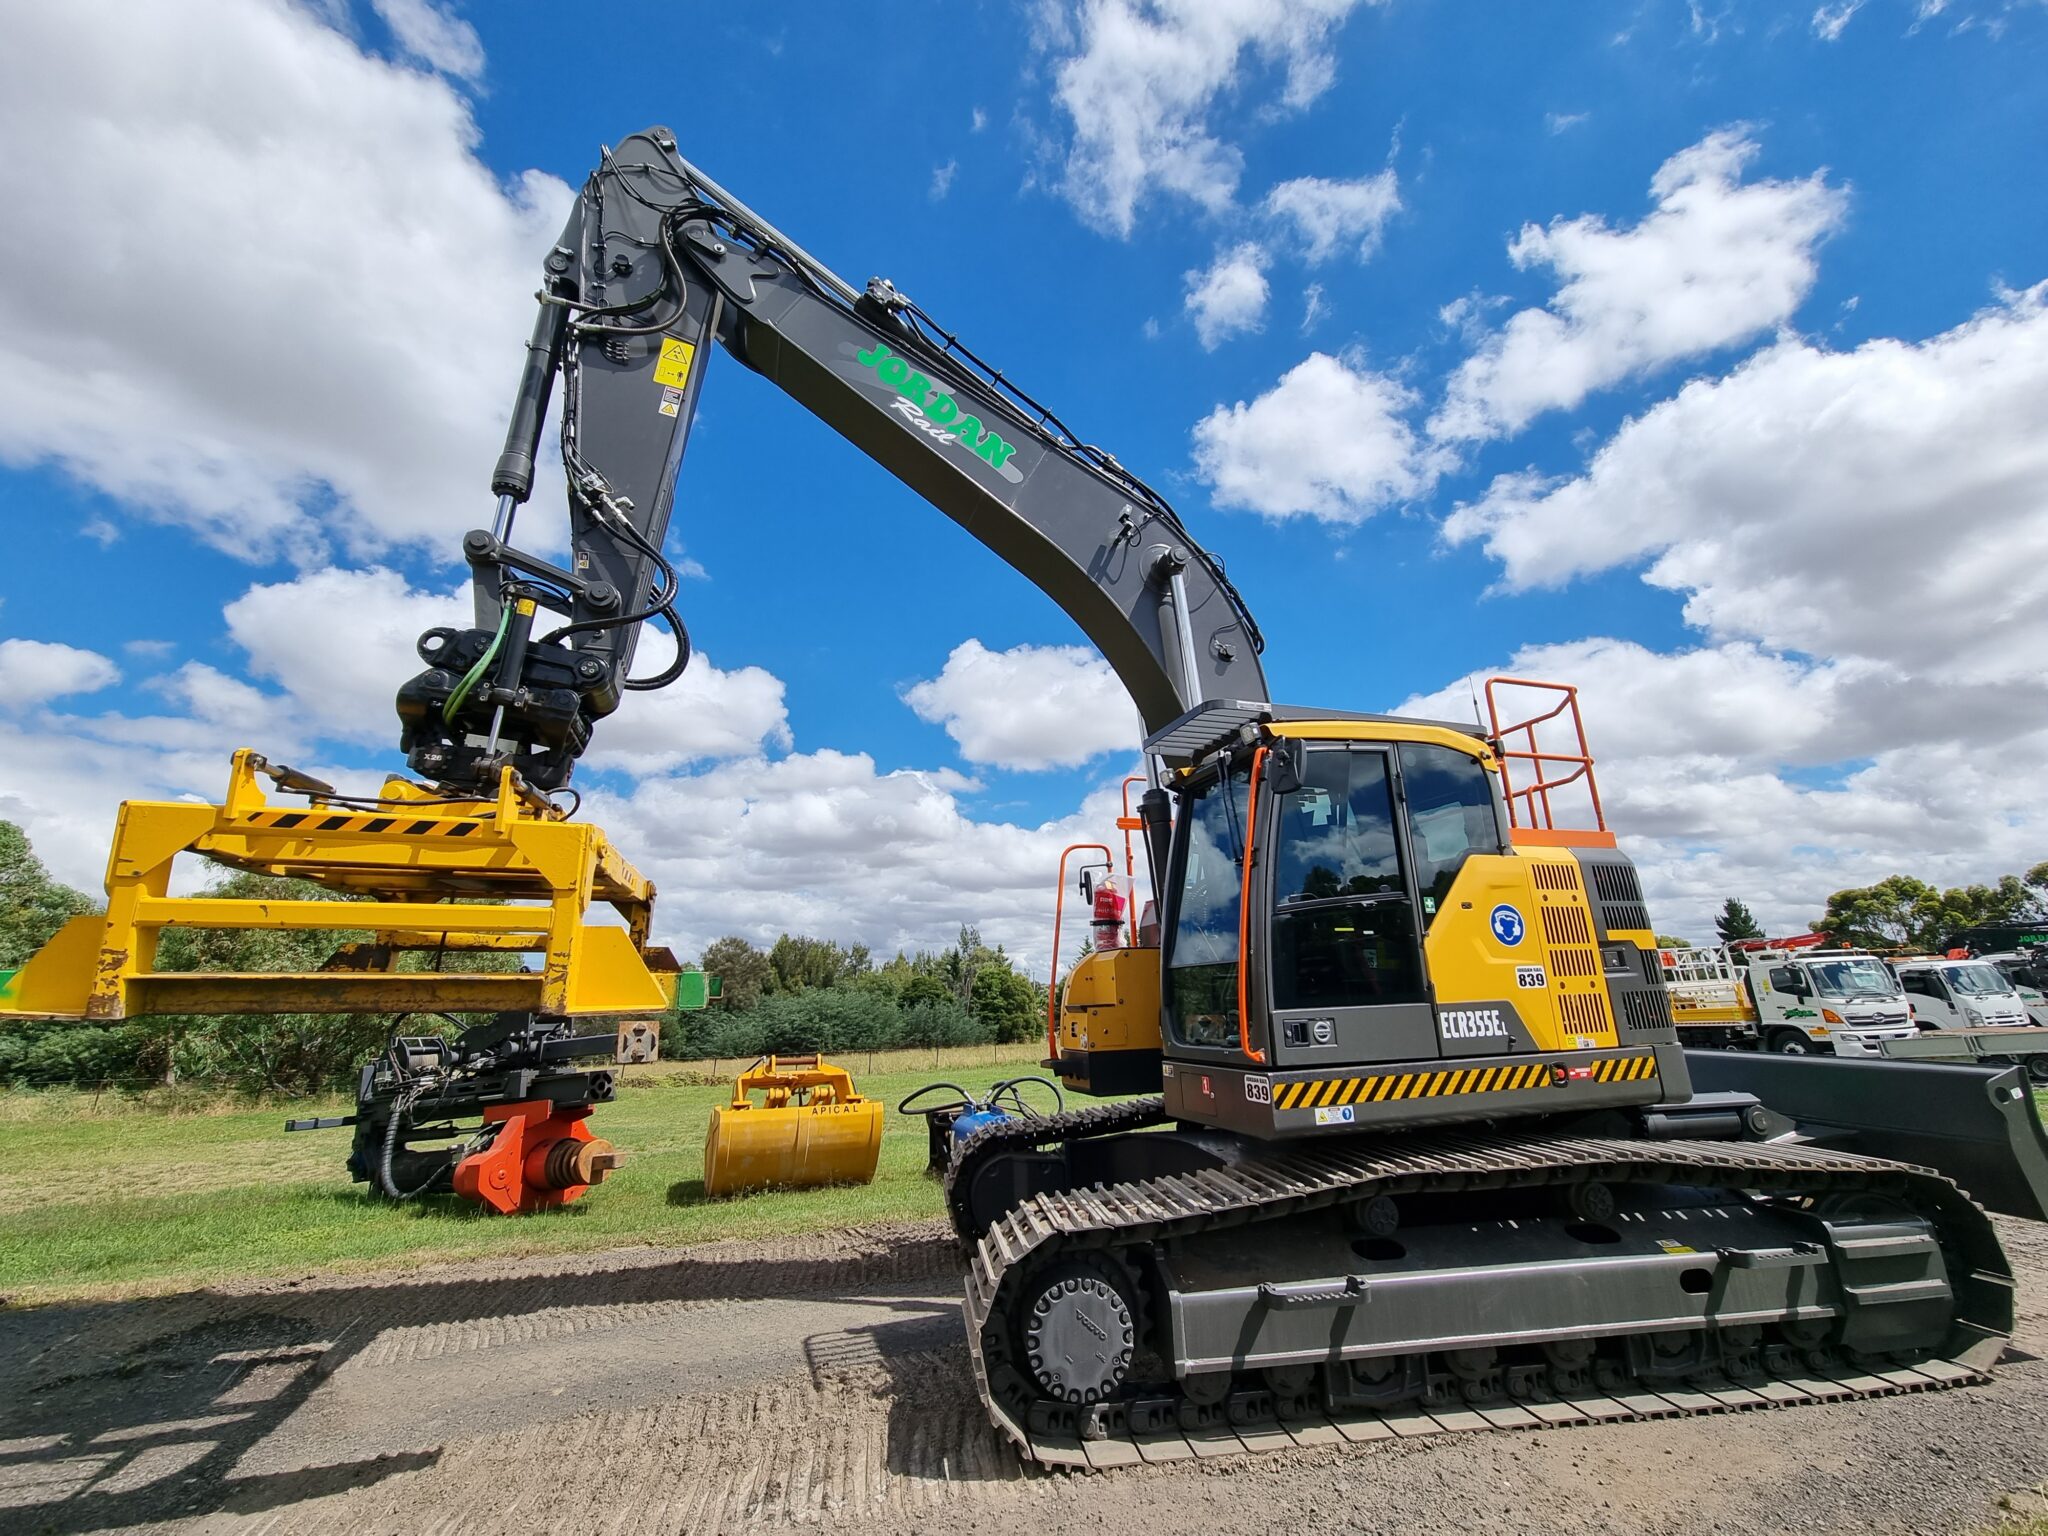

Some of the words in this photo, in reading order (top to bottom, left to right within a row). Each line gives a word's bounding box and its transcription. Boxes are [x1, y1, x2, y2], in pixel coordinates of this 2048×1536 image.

[857, 343, 1017, 469] JORDAN
[890, 396, 957, 446] Rail
[423, 753, 443, 761] X26
[1518, 973, 1545, 987] 839
[1247, 1083, 1269, 1102] 839
[811, 1104, 859, 1116] APICAL
